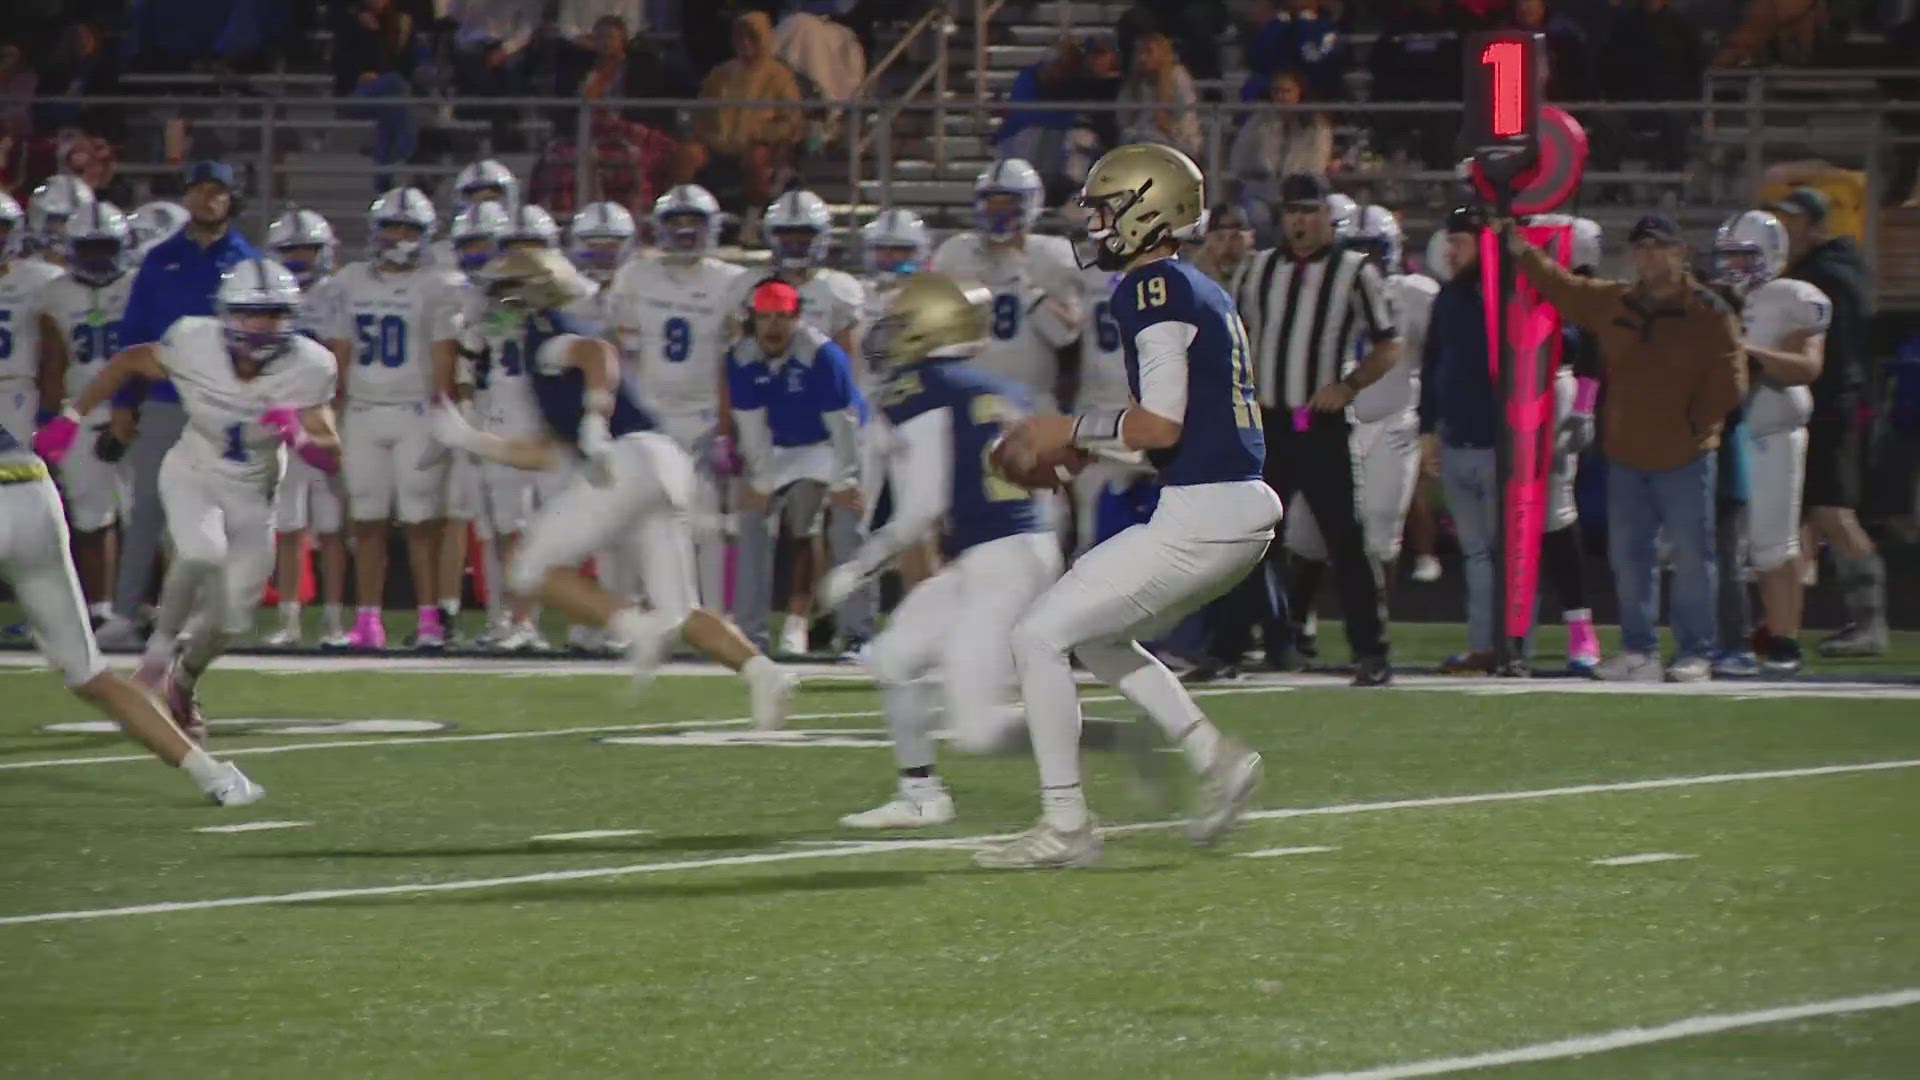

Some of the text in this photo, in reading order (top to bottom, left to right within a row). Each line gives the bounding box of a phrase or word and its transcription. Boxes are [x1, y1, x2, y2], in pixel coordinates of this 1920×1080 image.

[1482, 43, 1522, 134] 1
[993, 293, 1018, 340] 8
[1136, 277, 1167, 311] 19
[355, 314, 408, 368] 50
[222, 421, 247, 462] 1
